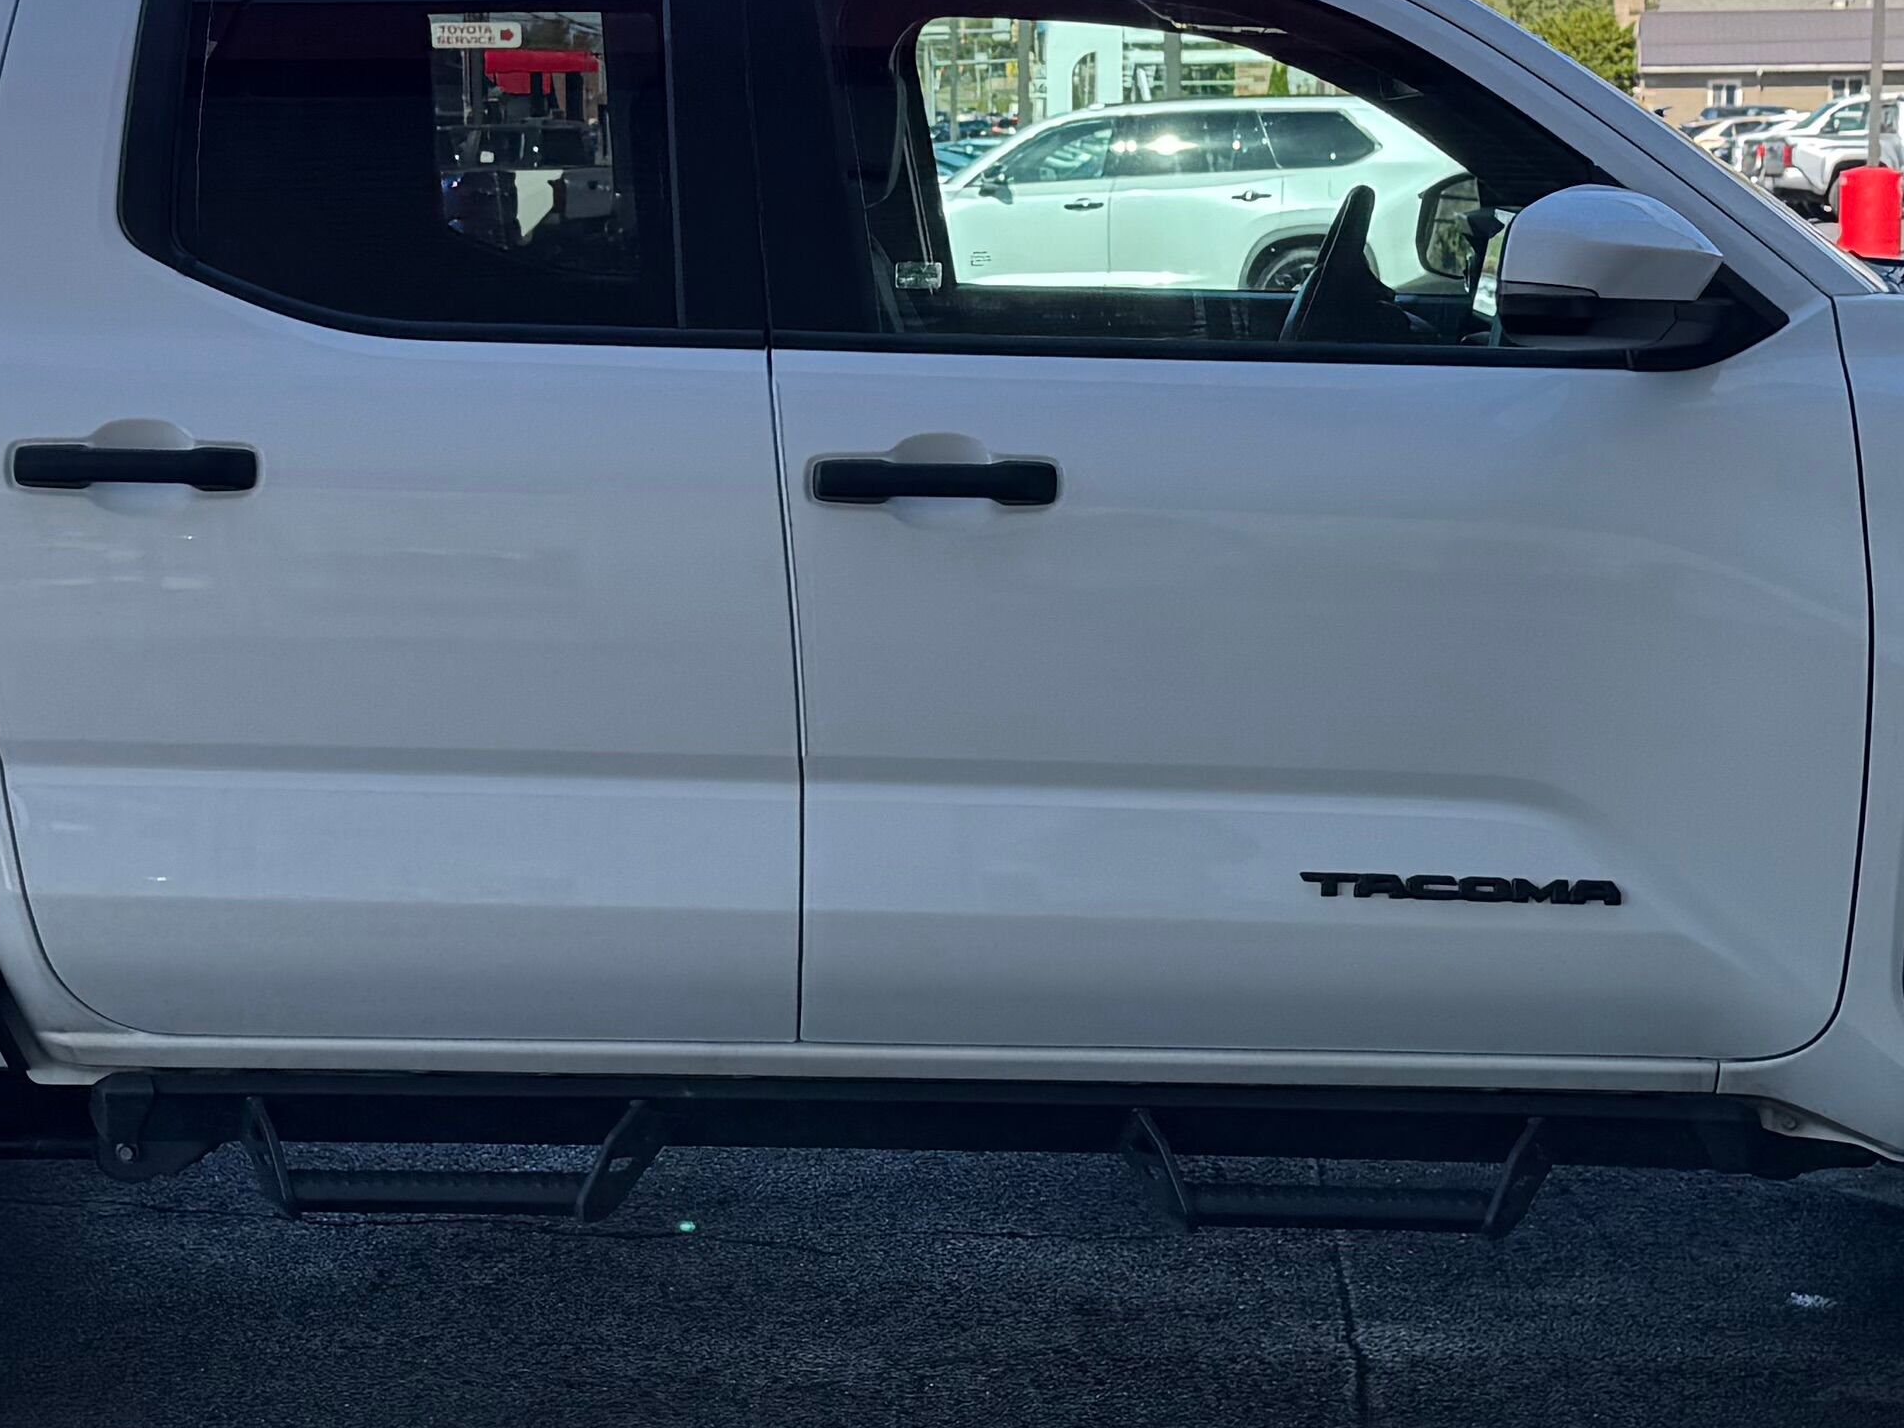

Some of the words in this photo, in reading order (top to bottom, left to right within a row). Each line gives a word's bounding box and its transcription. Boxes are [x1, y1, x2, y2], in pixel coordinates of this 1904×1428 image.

[437, 25, 492, 34] TOYOTA
[436, 36, 496, 45] SERVICE
[1299, 871, 1622, 906] TACOMA
